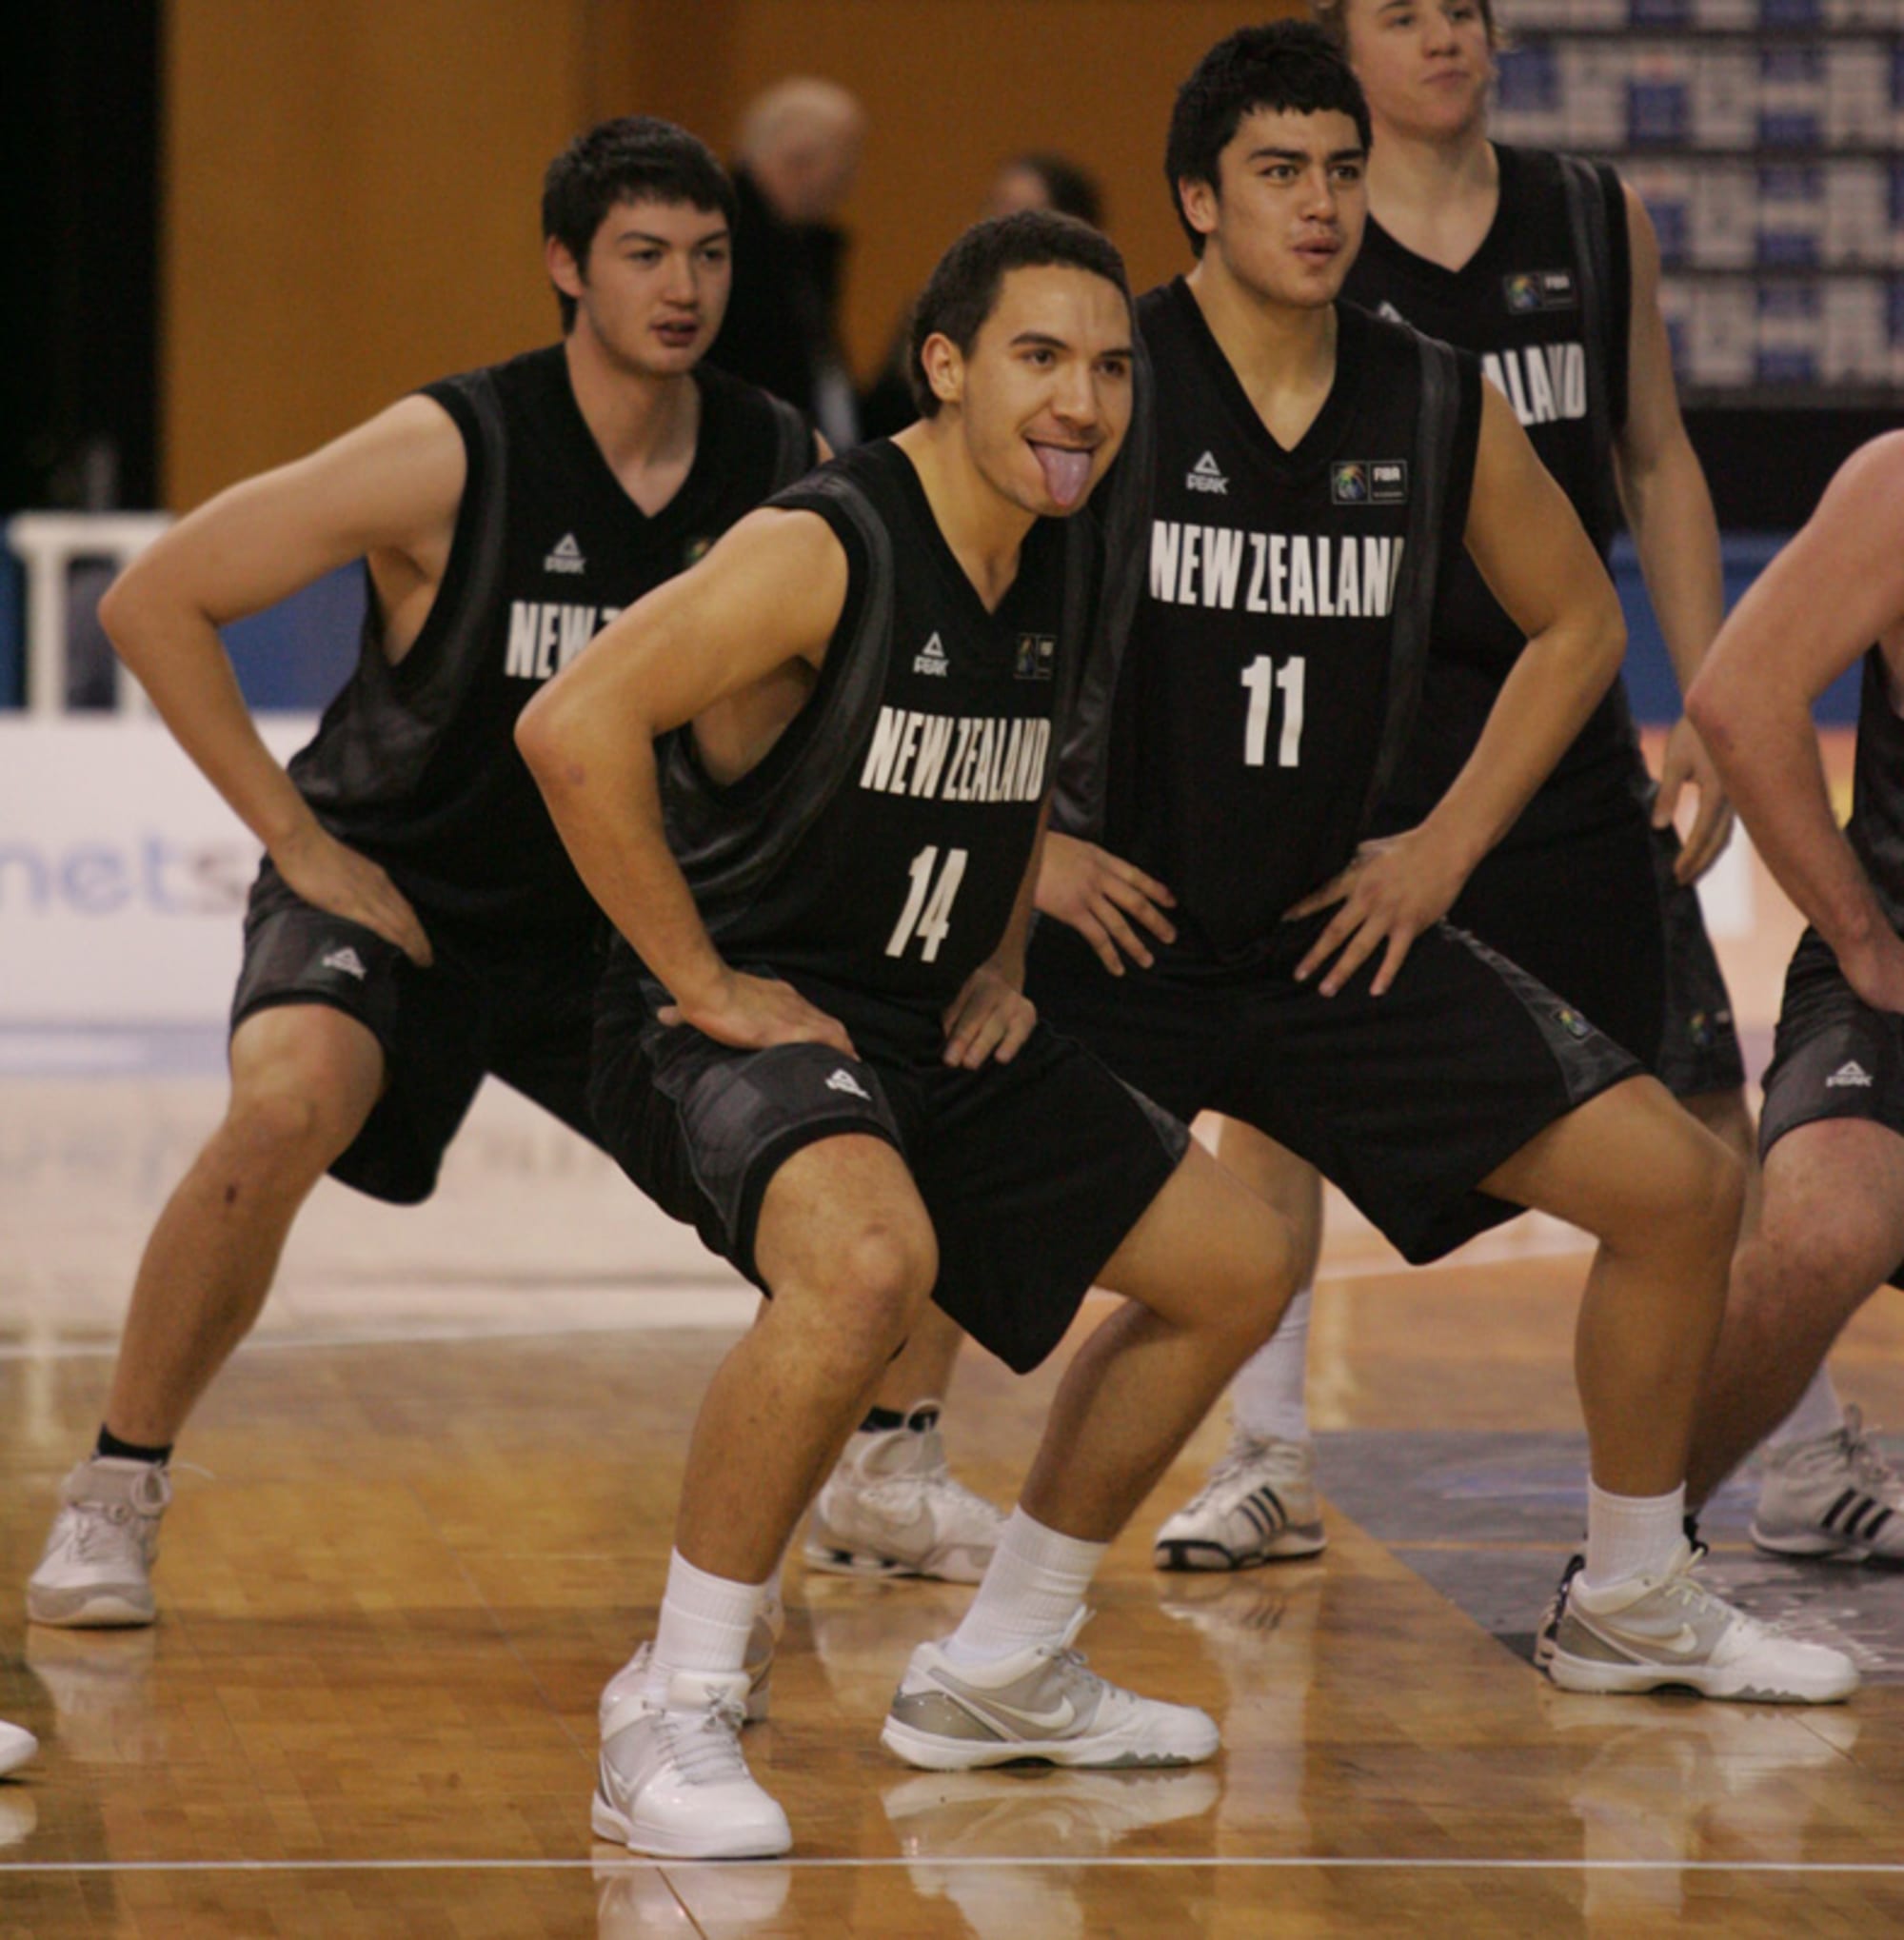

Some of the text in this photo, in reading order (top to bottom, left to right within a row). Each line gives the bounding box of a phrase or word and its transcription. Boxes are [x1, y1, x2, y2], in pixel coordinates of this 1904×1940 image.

[1186, 473, 1230, 495] PEAK
[1149, 520, 1244, 610] NEW
[505, 599, 598, 680] NEW
[859, 704, 1051, 802] NEW ZEALAND
[1240, 654, 1306, 767] 11
[884, 843, 968, 963] 14
